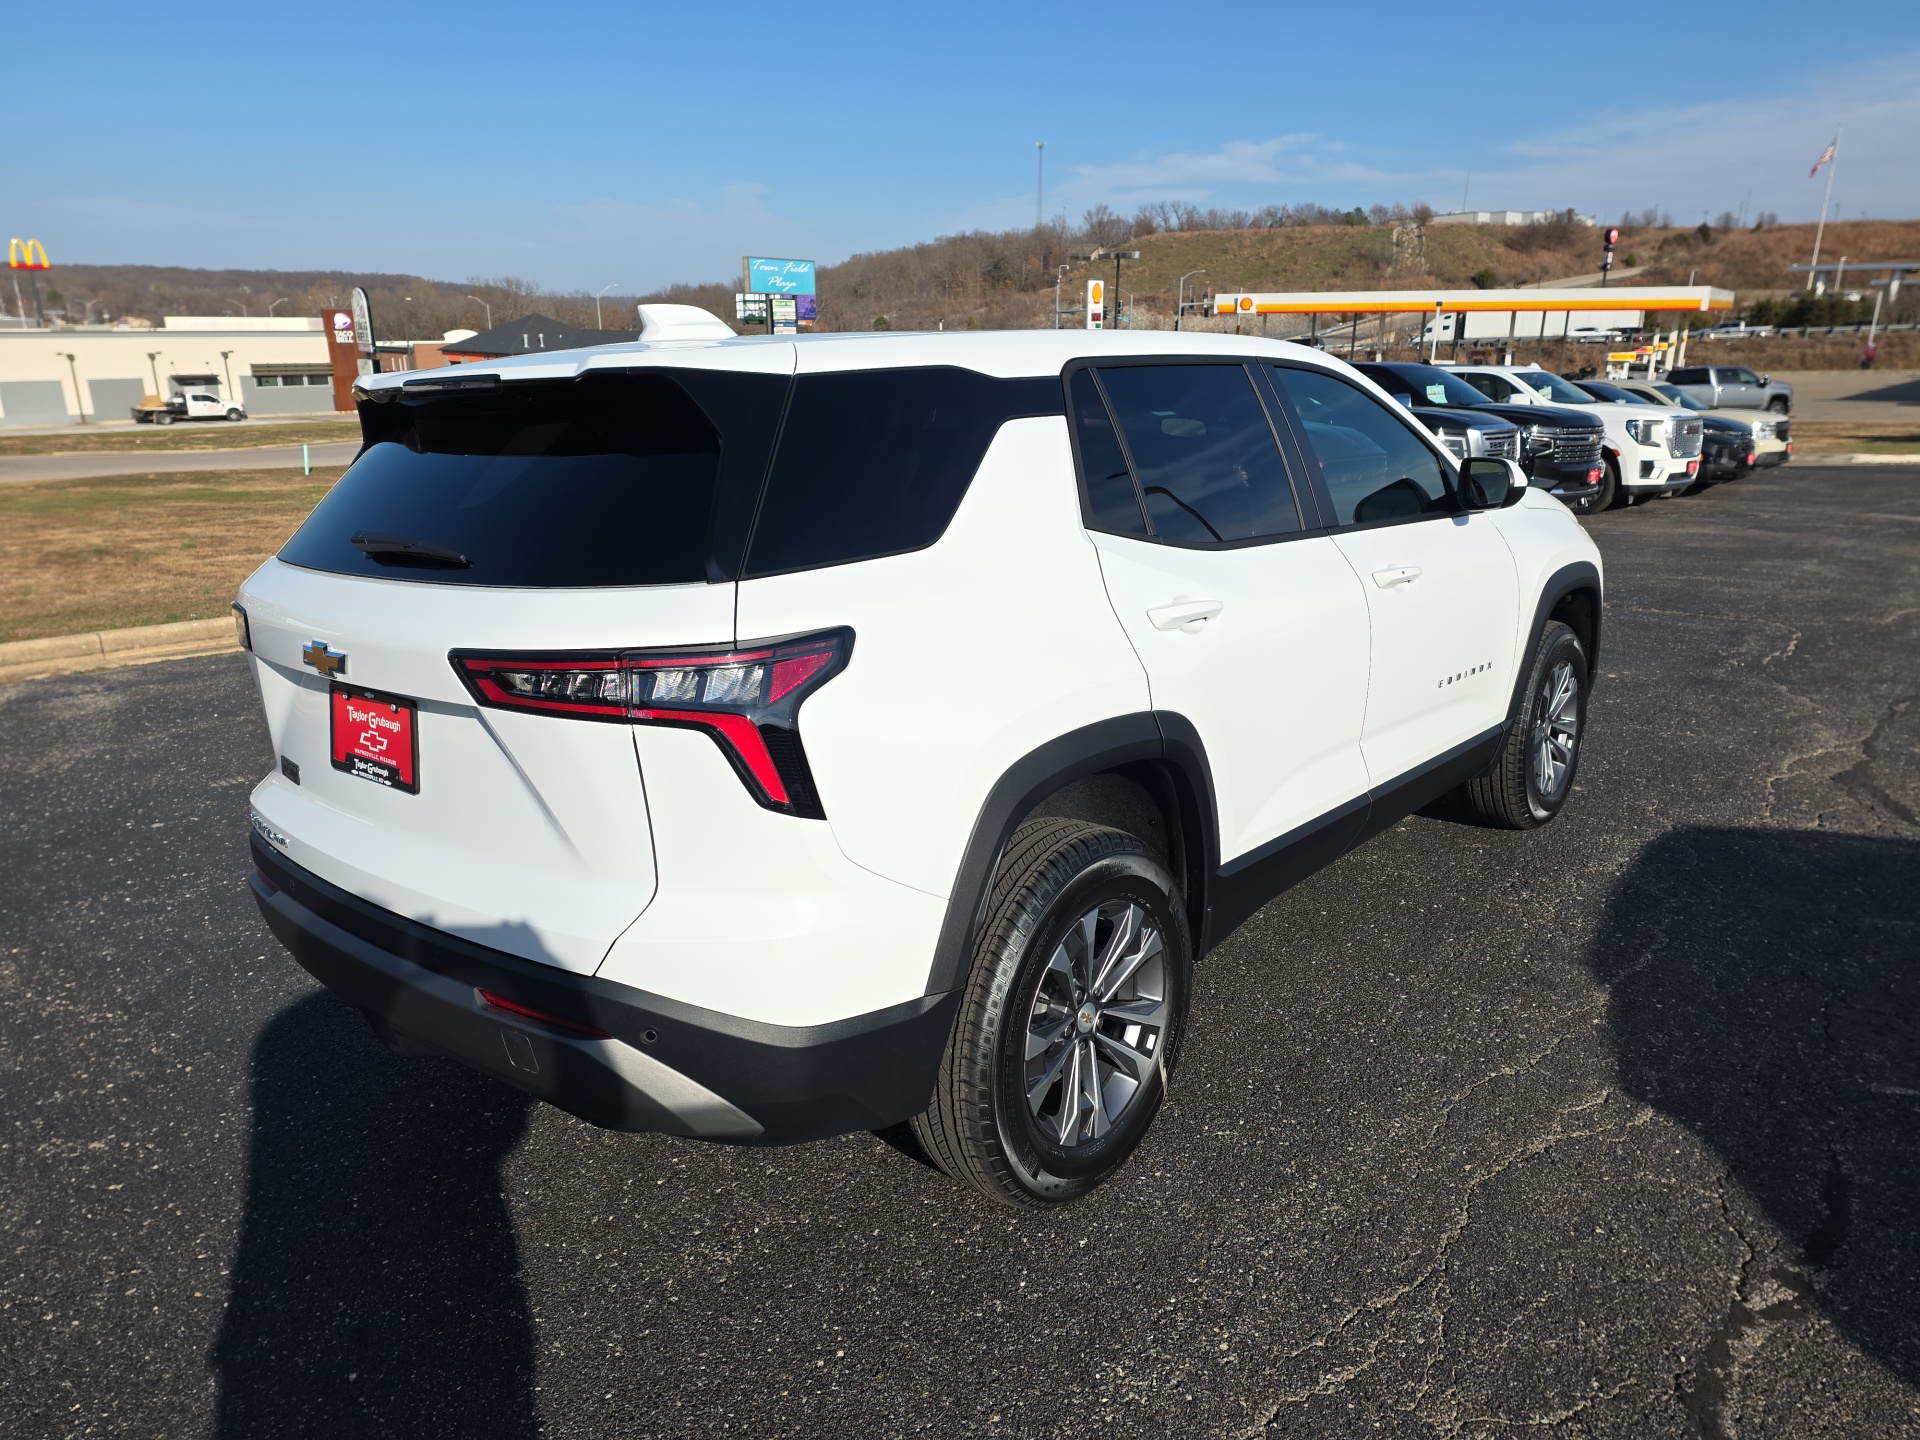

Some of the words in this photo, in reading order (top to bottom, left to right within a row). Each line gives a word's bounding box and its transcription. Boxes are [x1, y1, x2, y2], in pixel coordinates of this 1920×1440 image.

[753, 259, 779, 271] Town
[783, 262, 810, 274] Field
[768, 276, 796, 292] Plaza
[346, 705, 367, 722] Taylor
[368, 711, 401, 732] Grubaugh
